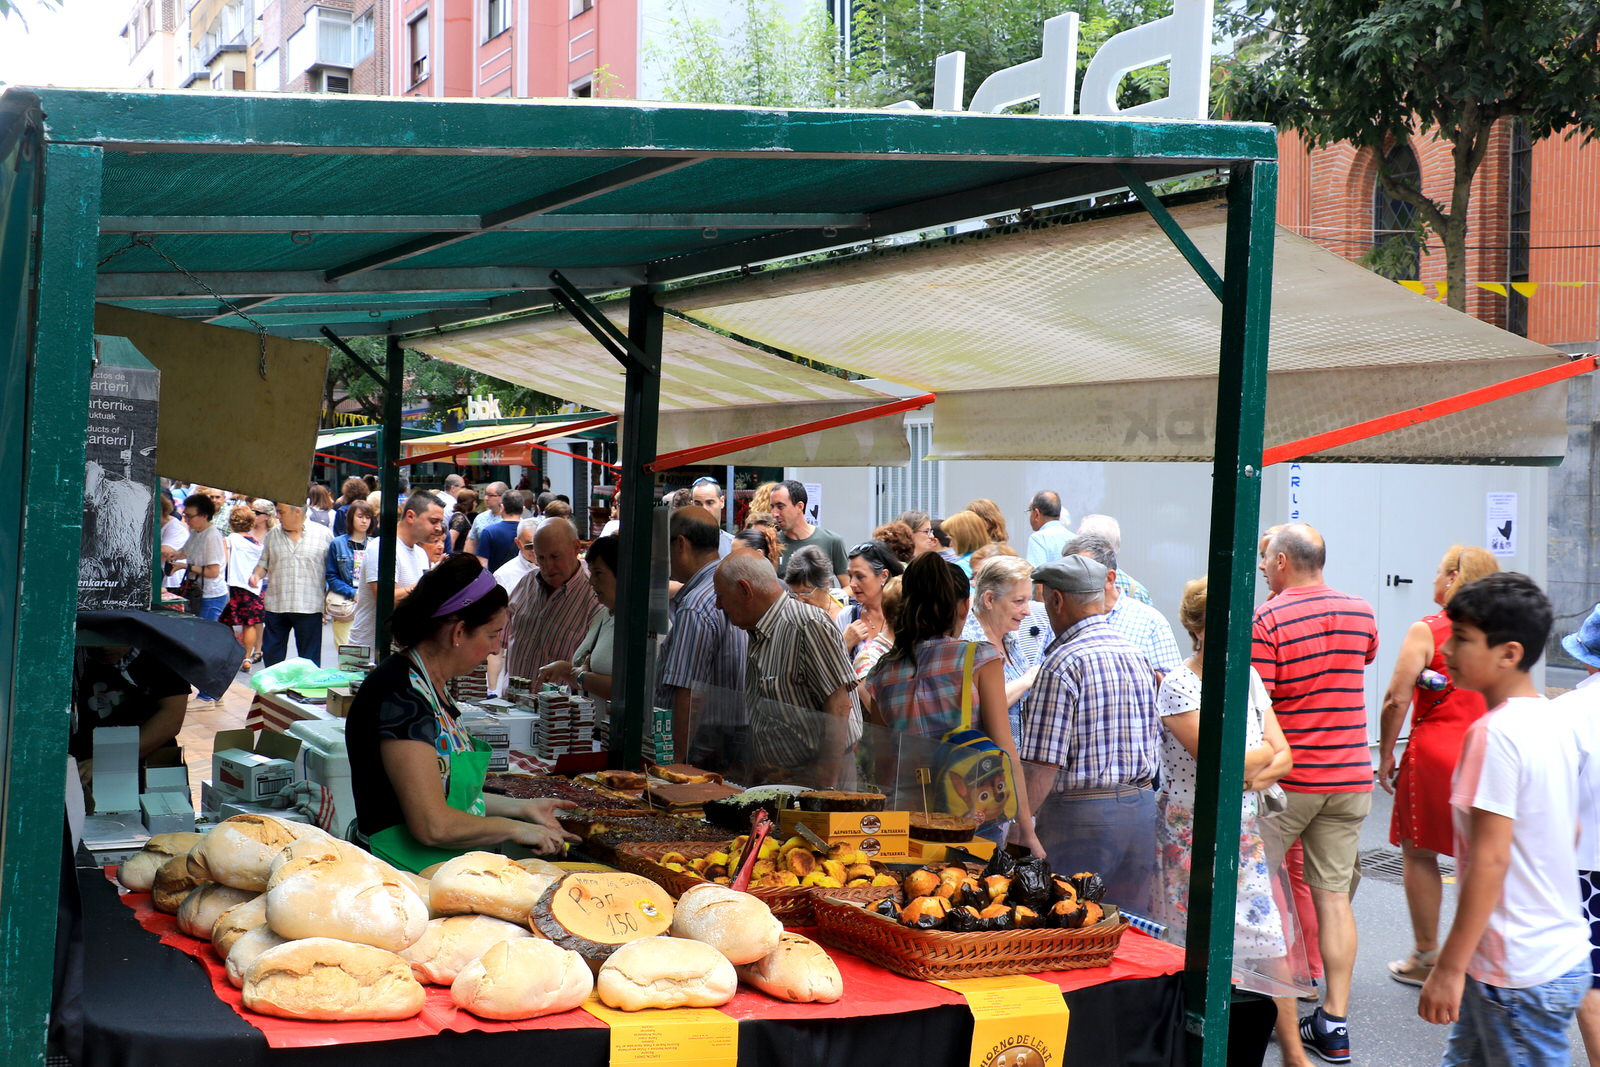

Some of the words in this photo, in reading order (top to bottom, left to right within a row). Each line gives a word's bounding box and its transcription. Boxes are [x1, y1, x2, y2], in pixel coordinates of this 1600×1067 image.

[90, 380, 129, 393] arterri
[114, 373, 126, 381] de
[467, 393, 504, 421] bbk
[111, 426, 120, 434] of
[568, 887, 615, 913] Pan
[980, 1036, 1014, 1067] HORNO
[1016, 1034, 1030, 1044] DE
